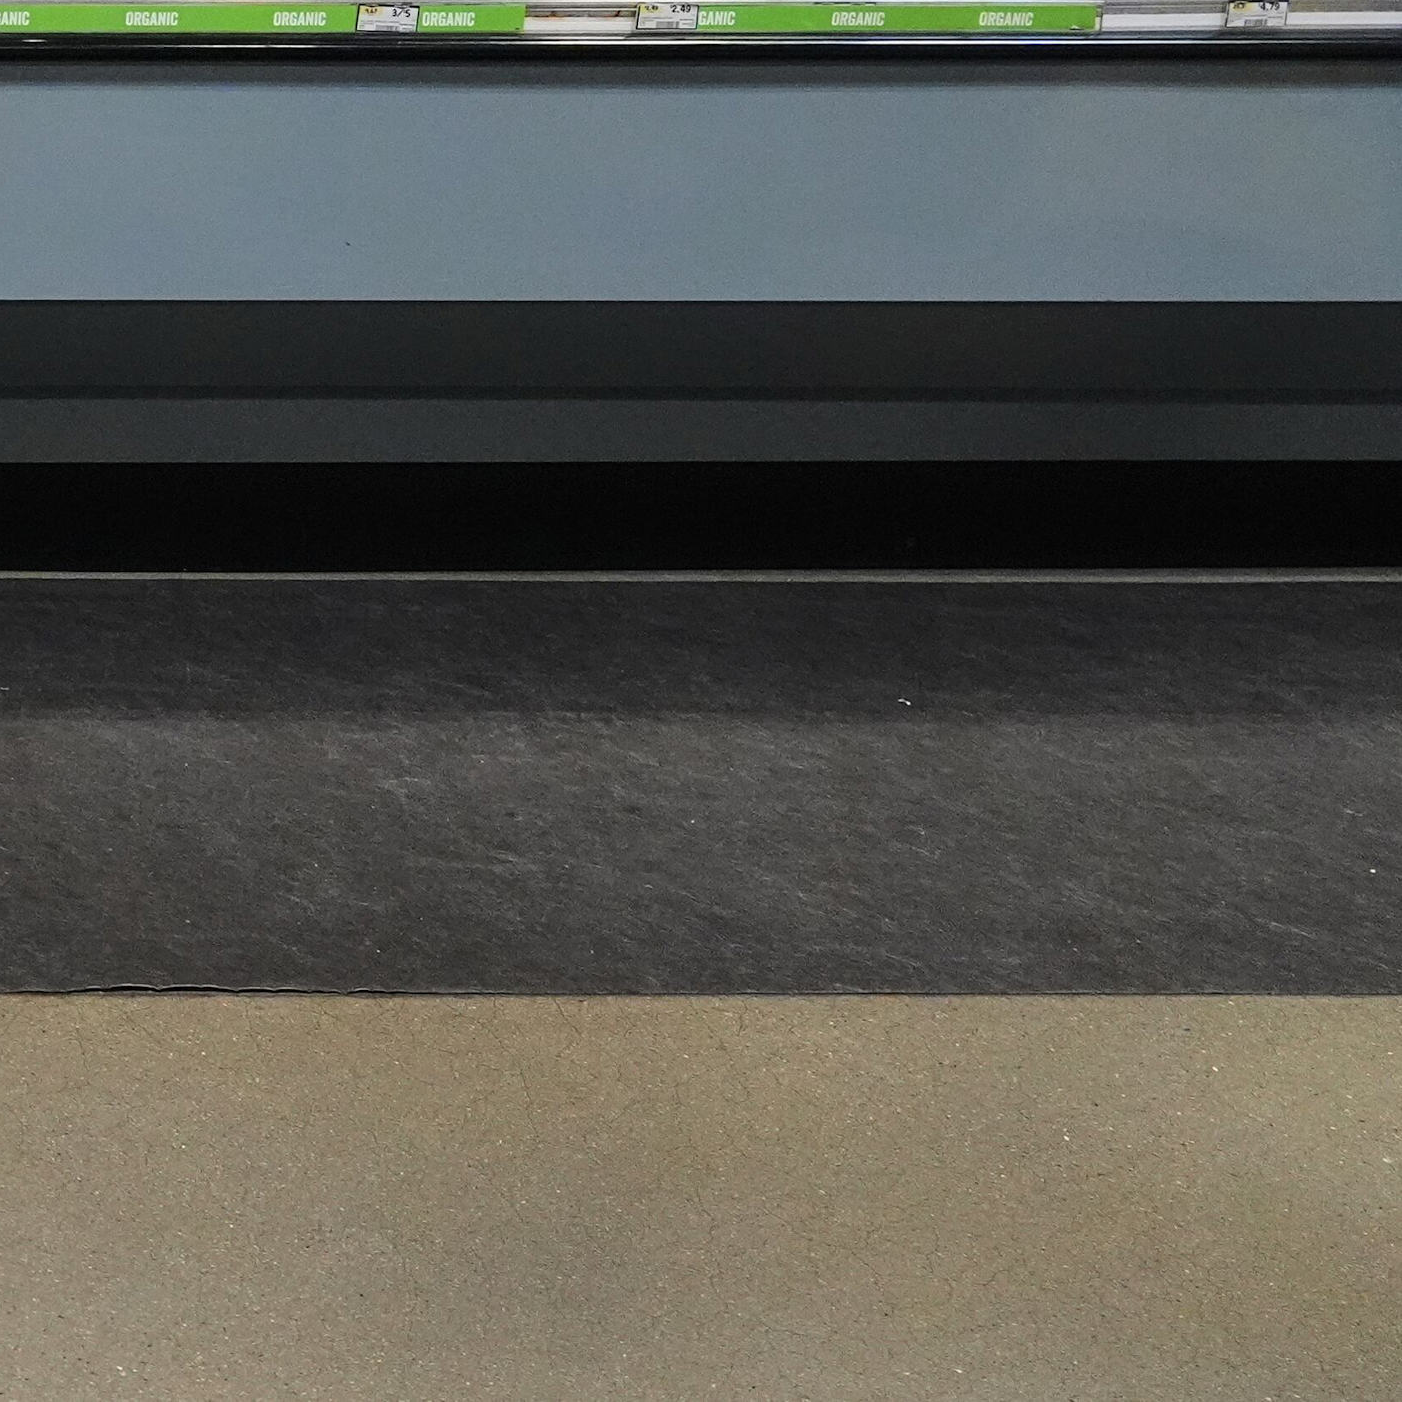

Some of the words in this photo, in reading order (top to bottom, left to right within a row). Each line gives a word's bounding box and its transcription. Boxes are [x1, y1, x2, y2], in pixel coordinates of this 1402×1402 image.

[125, 11, 179, 26] ORGANIC
[273, 11, 326, 26] ORGANIC
[422, 11, 475, 27] ORGANIC
[699, 11, 736, 26] GANIC
[831, 11, 885, 27] ORGANIC
[979, 11, 1034, 27] ORGANIC
